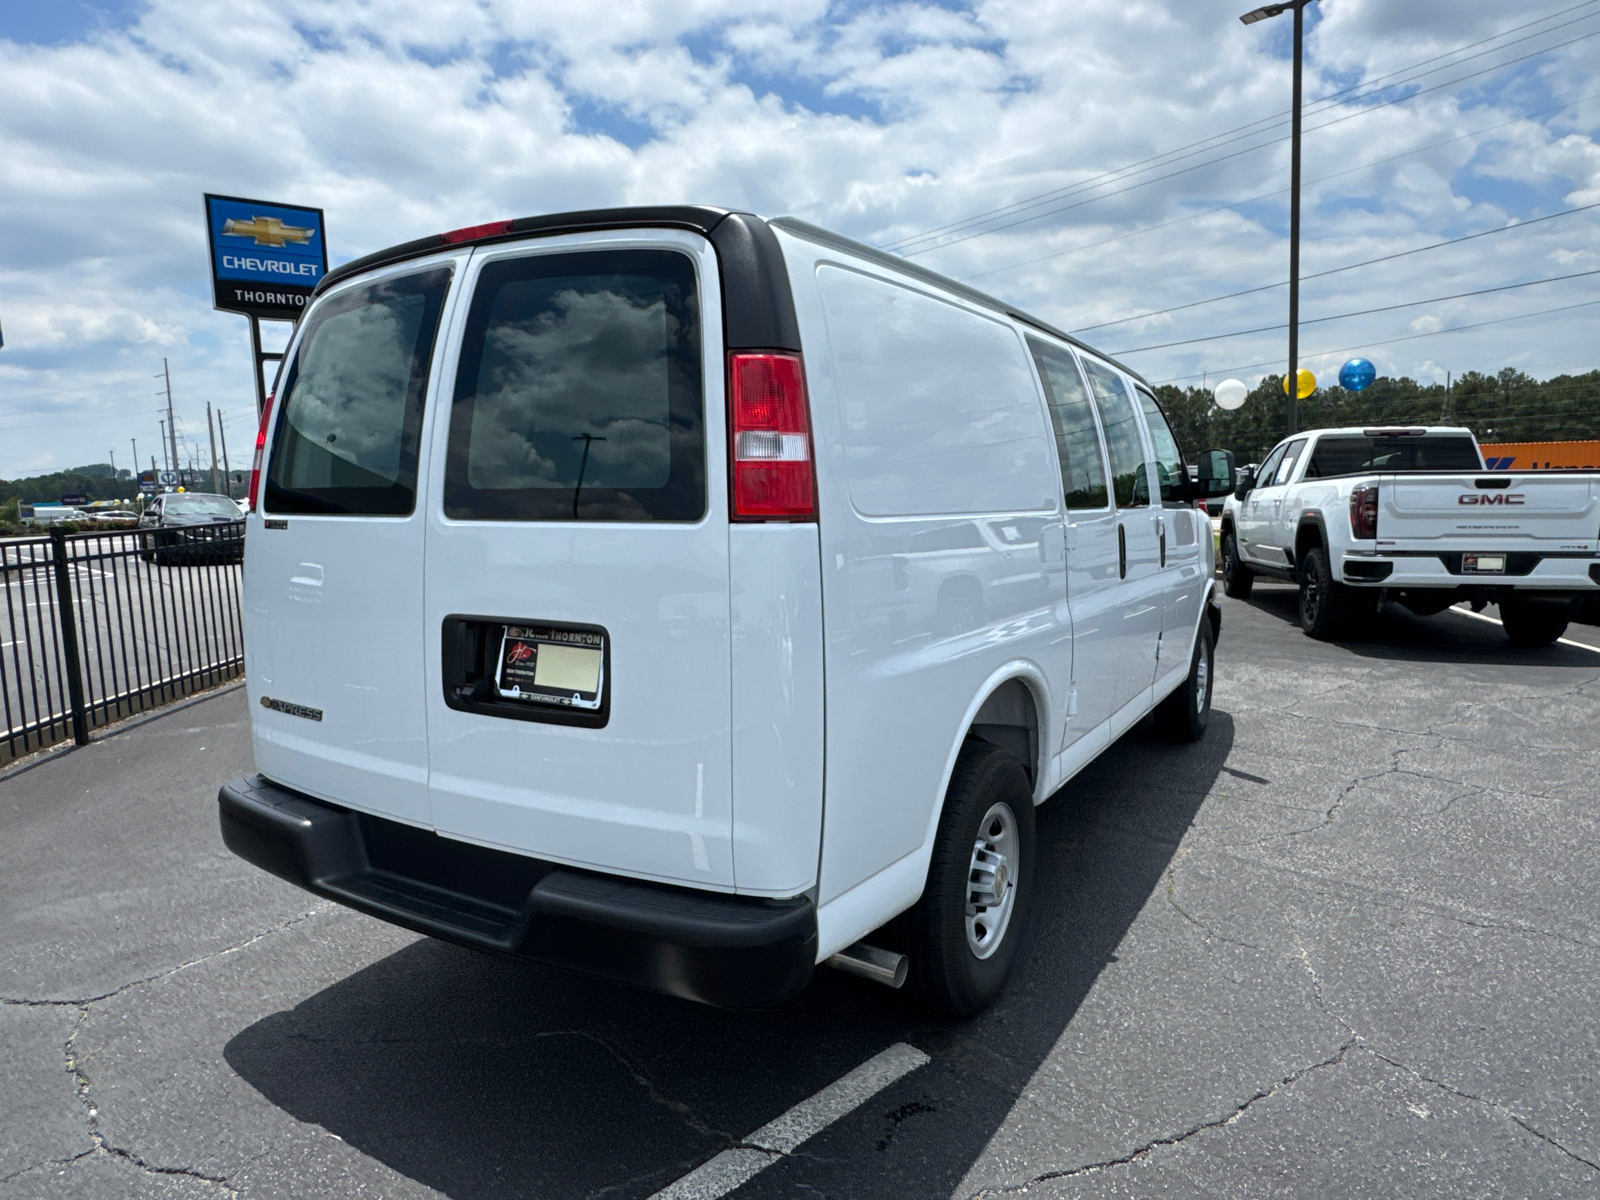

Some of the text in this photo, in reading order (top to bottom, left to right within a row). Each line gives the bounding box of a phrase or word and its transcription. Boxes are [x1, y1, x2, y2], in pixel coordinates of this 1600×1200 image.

[222, 255, 318, 276] CHEVROLET
[1458, 494, 1525, 505] GMC
[550, 630, 600, 644] THORNTON
[271, 699, 322, 721] EXPRESS
